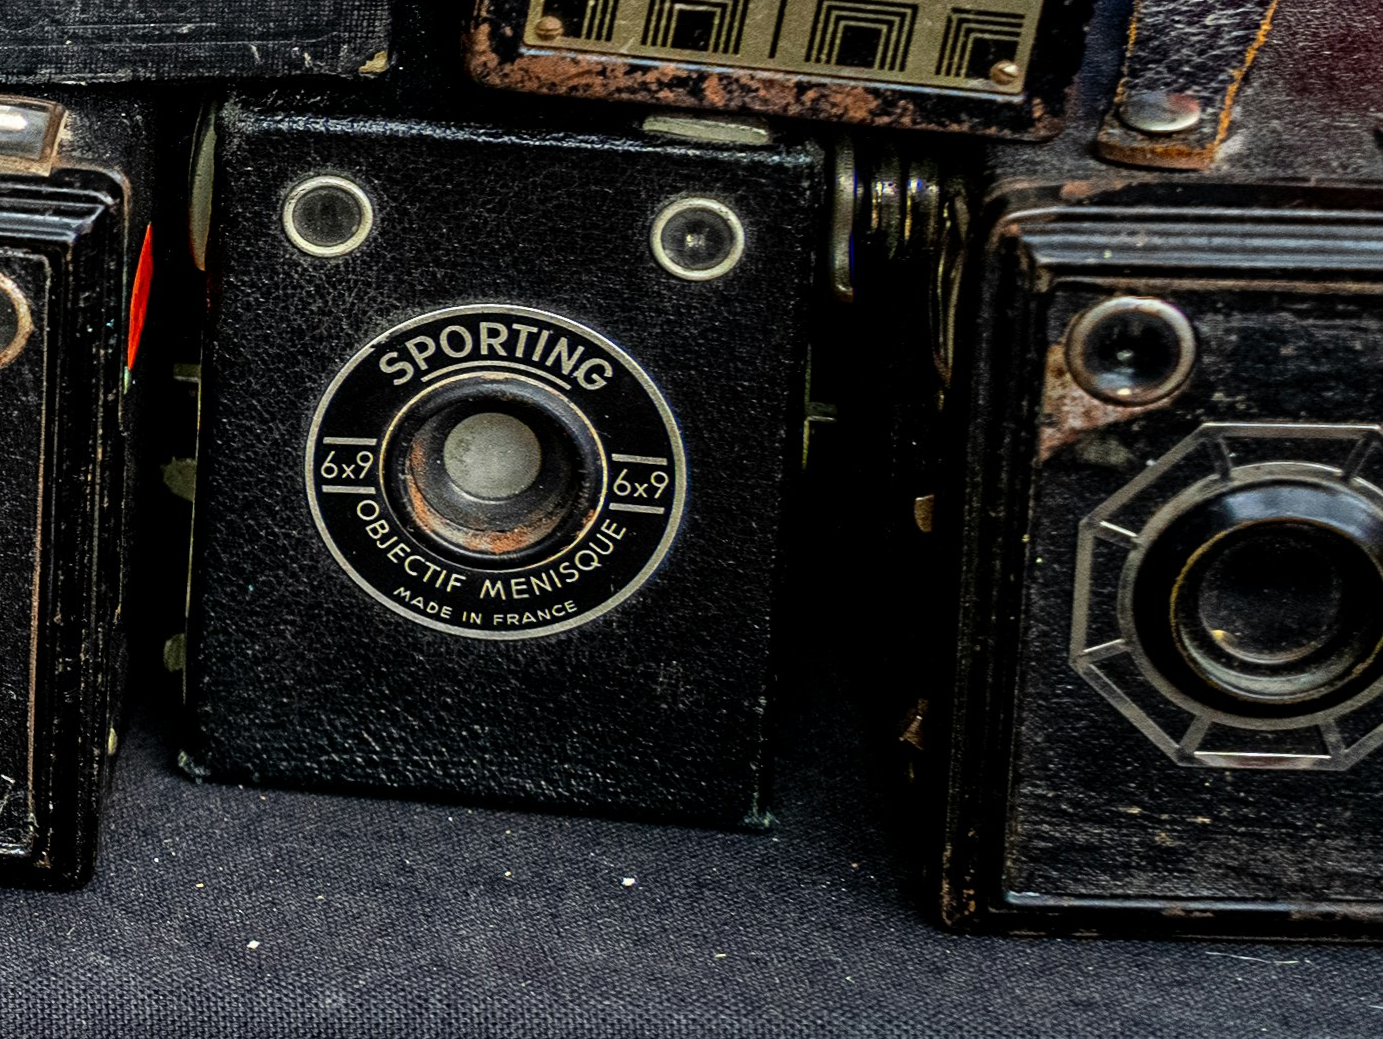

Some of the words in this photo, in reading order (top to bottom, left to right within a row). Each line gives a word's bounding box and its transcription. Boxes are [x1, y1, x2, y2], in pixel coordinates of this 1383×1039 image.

[379, 321, 614, 391] SPORTING
[320, 450, 374, 480] 6x9
[612, 469, 669, 499] 6x9
[356, 499, 468, 593] OBJECTIF
[479, 518, 628, 601] MENISQUE
[393, 585, 453, 619] MADE
[463, 611, 483, 625] IN
[494, 599, 579, 626] FRANCE
